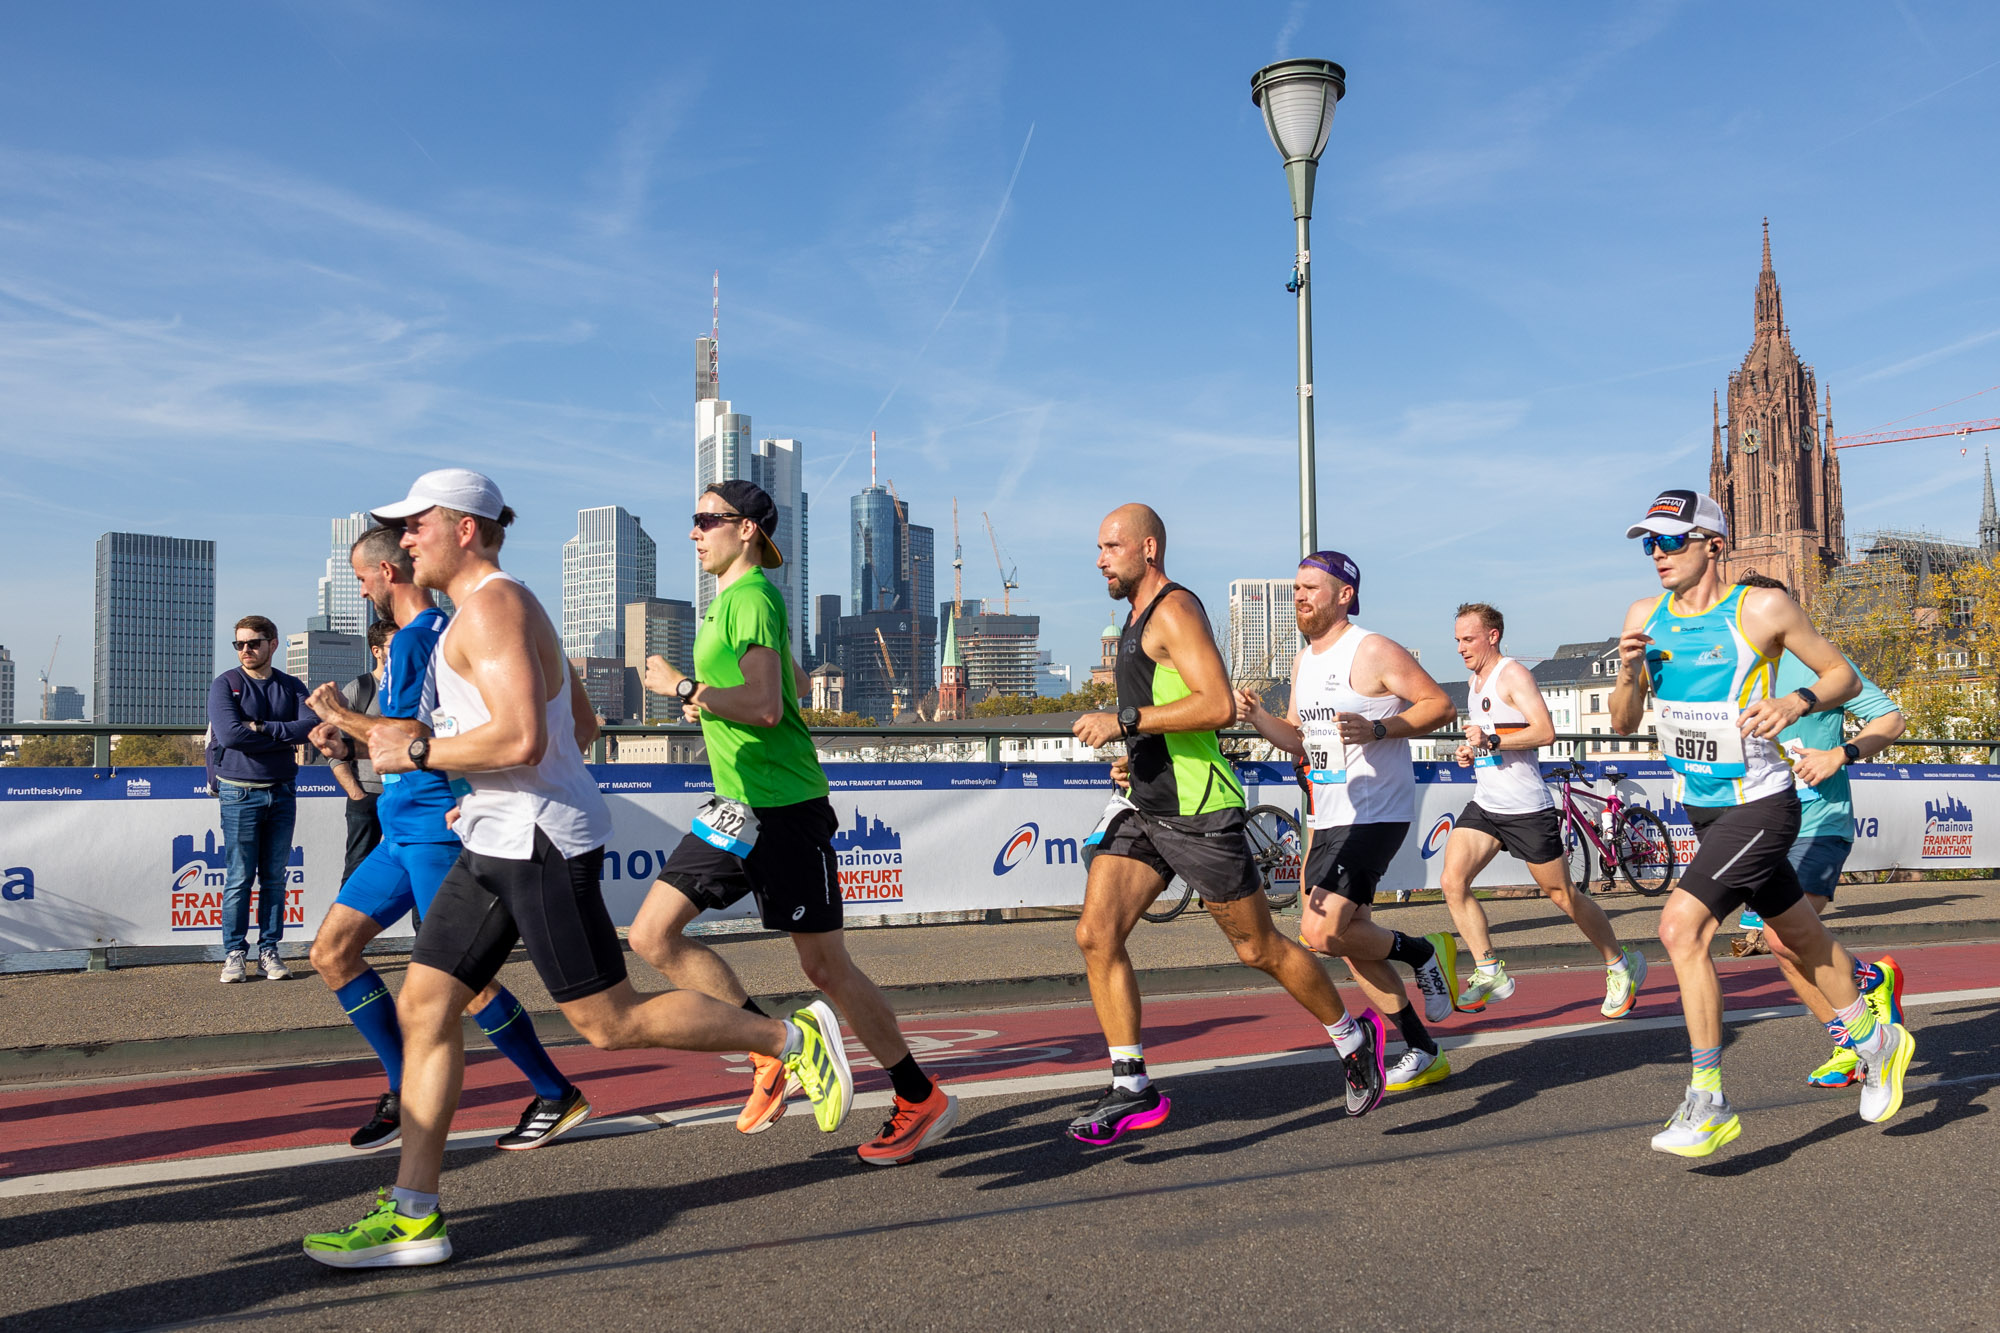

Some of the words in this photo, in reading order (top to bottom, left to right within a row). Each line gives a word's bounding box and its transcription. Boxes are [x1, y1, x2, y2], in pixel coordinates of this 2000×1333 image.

[1299, 701, 1336, 722] swim
[1672, 709, 1729, 721] mainova
[1678, 728, 1707, 740] Wolfgang
[1675, 737, 1718, 762] 6979
[1684, 763, 1713, 775] HOKA
[612, 781, 652, 789] MARATHON
[849, 779, 886, 787] FRANKFURT
[951, 778, 997, 786] #runtheskyline
[7, 787, 83, 797] #runtheskyline
[296, 785, 336, 793] ARATHON
[1646, 825, 1695, 838] manova
[1936, 820, 1973, 832] mainova
[1923, 835, 1973, 845] FRANKFURT
[1921, 845, 1973, 856] MARATHON
[1429, 966, 1447, 995] HOKA
